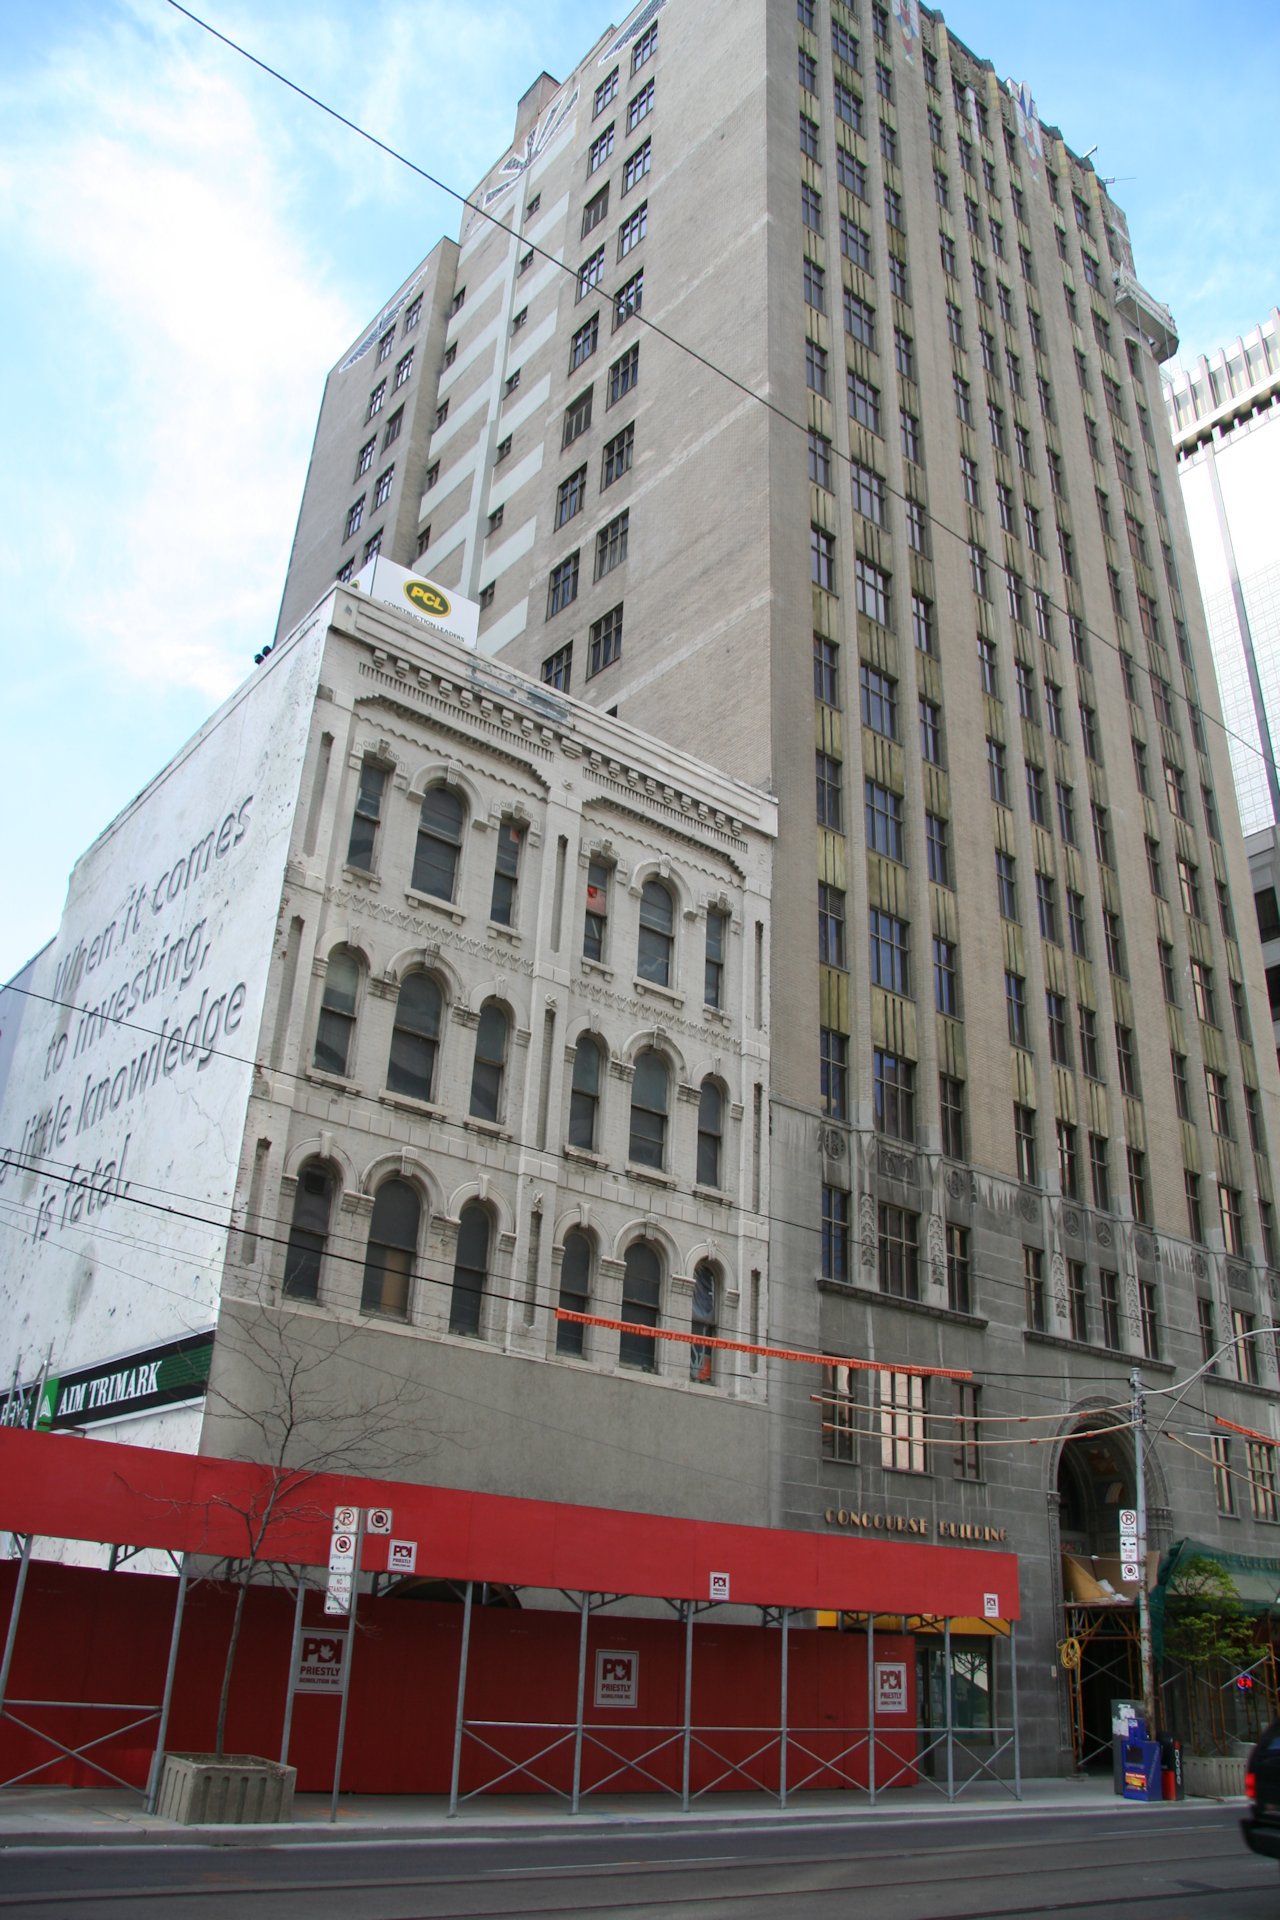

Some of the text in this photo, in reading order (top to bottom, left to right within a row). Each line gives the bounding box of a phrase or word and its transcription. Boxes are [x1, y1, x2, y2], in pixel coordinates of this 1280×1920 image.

[383, 600, 465, 643] CONSTRUCTION LEADERS
[411, 586, 443, 611] PCL
[51, 795, 253, 1007] When it comes
[44, 917, 211, 1082] to investing,
[15, 1094, 72, 1176] little
[76, 981, 247, 1136] knowledge
[33, 1132, 132, 1245] is fatal.
[57, 1382, 88, 1417] AIM
[88, 1360, 163, 1409] TRIMARK
[825, 1507, 1008, 1542] CONCOURSE BUILDING
[300, 1666, 341, 1677] PRIESTLY
[601, 1683, 632, 1692] PRIESTLY
